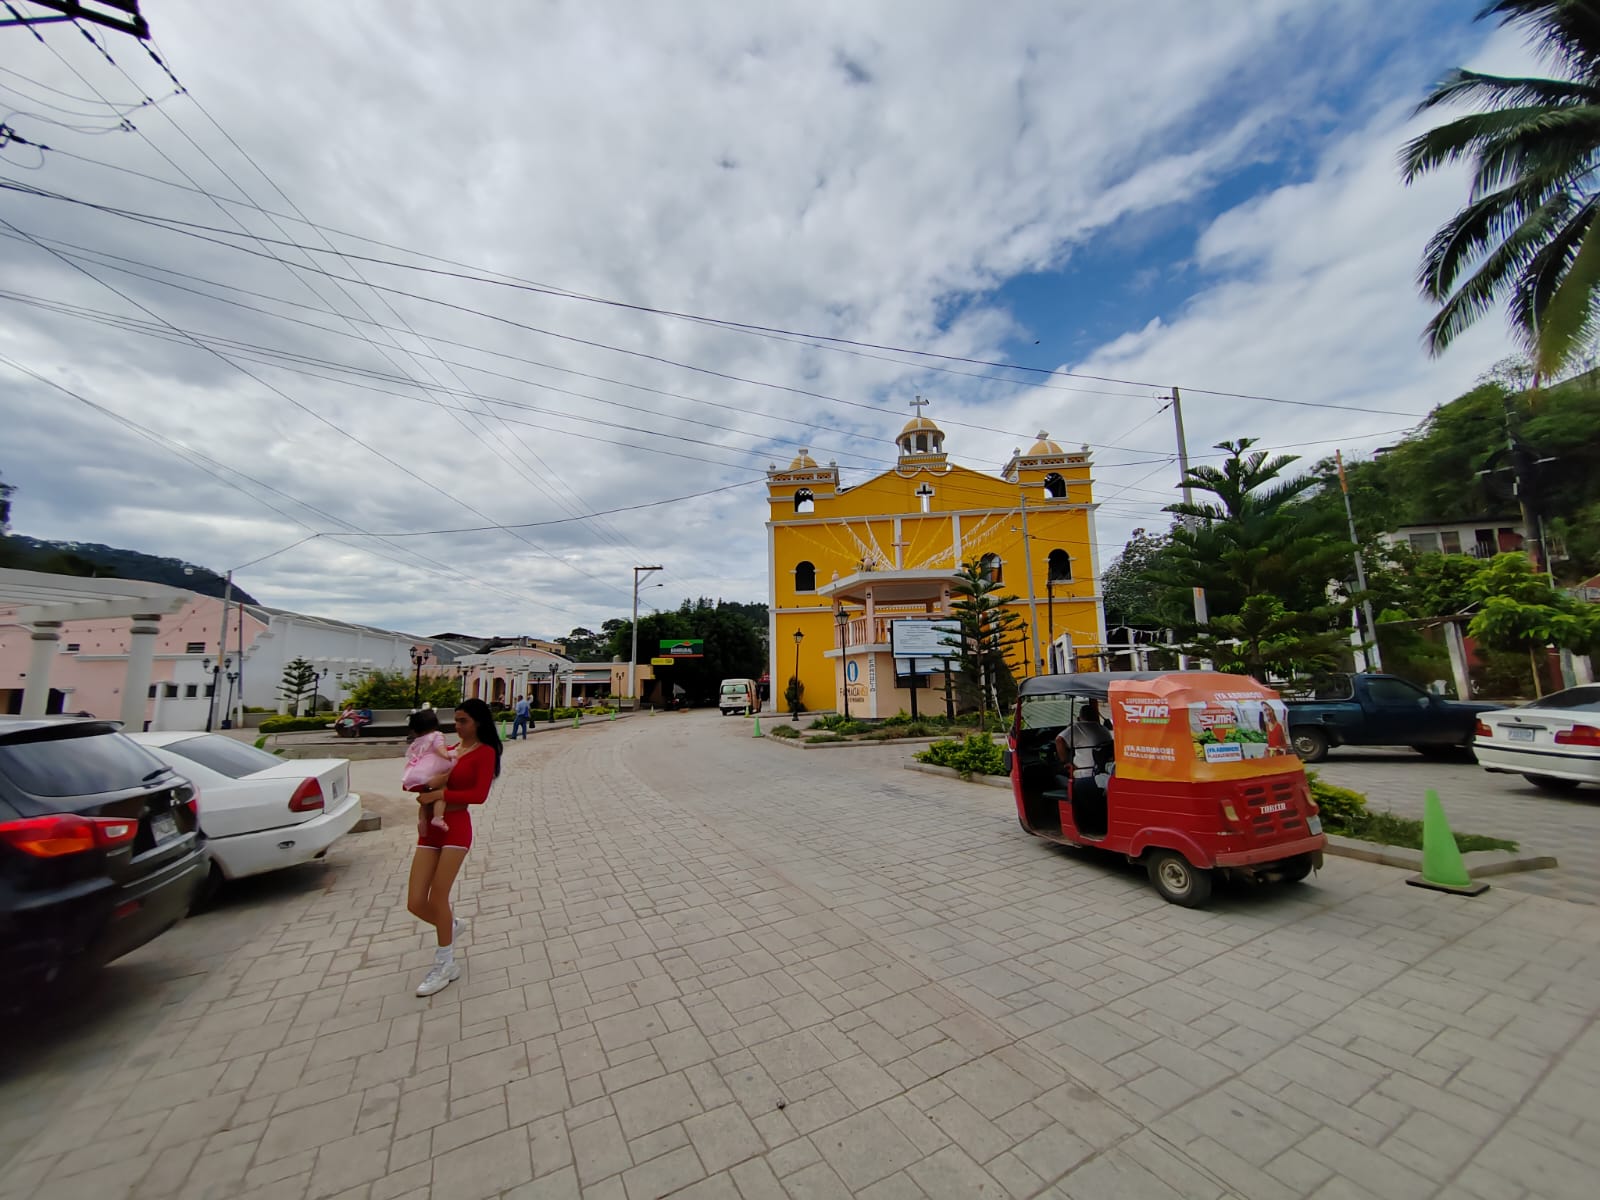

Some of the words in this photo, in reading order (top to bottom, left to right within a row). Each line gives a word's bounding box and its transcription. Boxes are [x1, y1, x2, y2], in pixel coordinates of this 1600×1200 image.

[1122, 704, 1169, 718] SUMA
[1199, 714, 1233, 726] SUMA
[1260, 803, 1286, 814] TORITO
